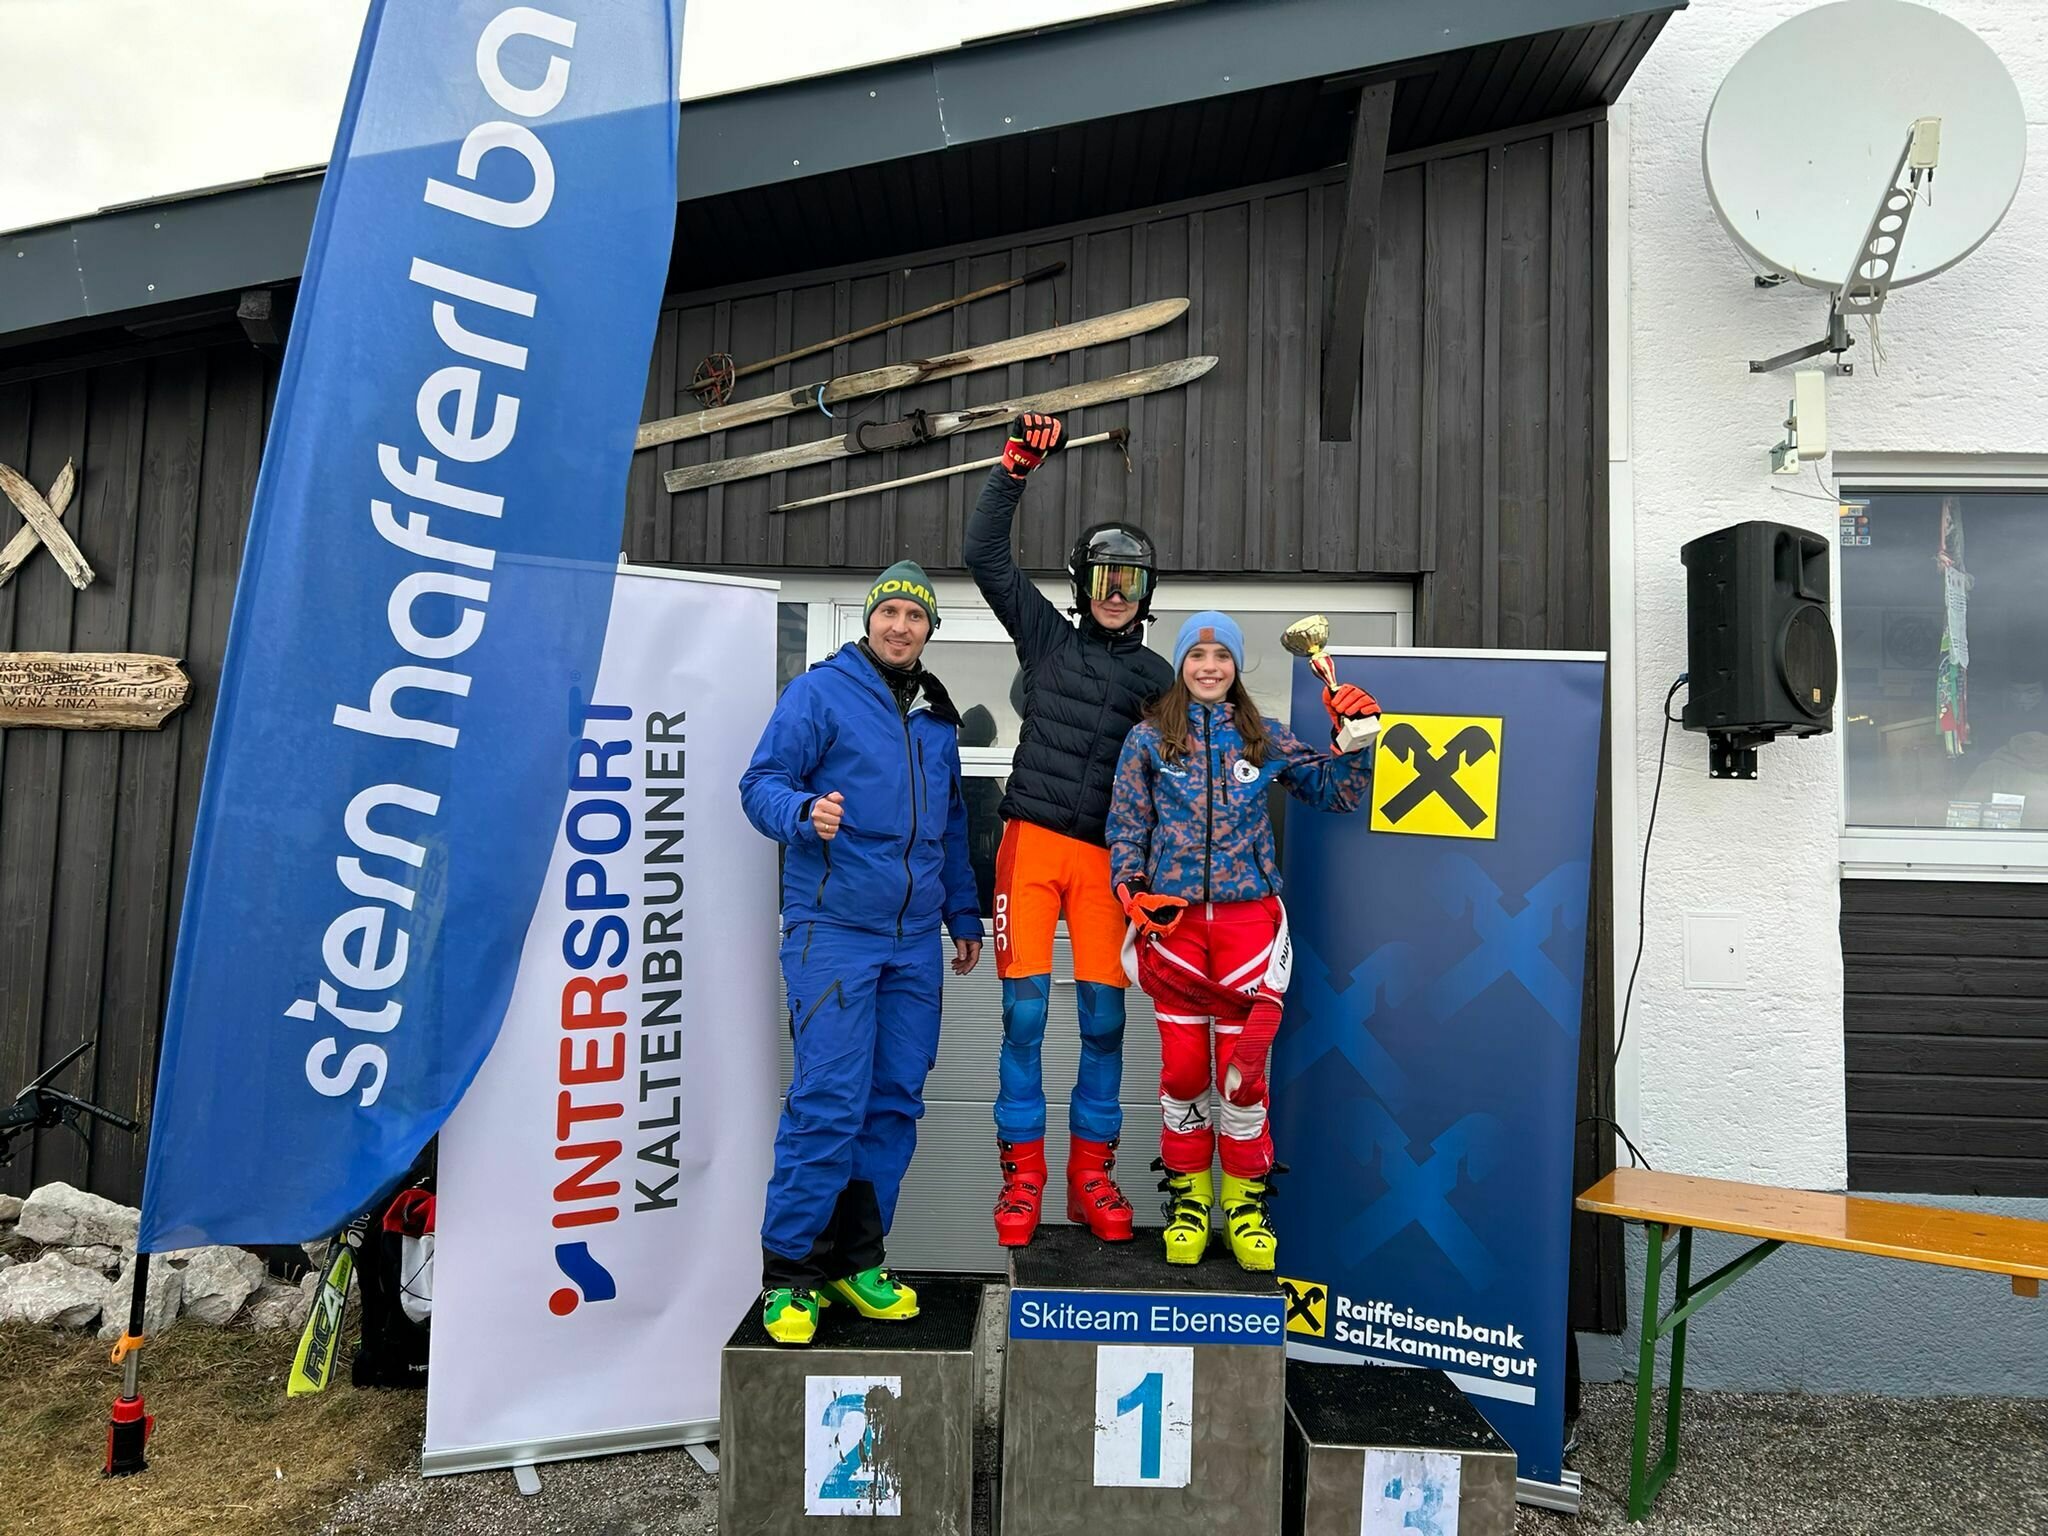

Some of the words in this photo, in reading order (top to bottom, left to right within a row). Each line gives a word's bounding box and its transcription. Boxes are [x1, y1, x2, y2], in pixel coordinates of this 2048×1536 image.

[423, 7, 578, 229] ba
[332, 256, 537, 749] hafferl
[1008, 449, 1031, 466] LEKI
[866, 579, 937, 614] ATOMIC
[283, 783, 441, 1108] stern
[551, 687, 633, 1228] INTERSPORT
[634, 710, 687, 1213] KALTENBRUNNER
[303, 1281, 346, 1387] RC4
[1019, 1301, 1139, 1332] Skiteam
[1150, 1306, 1281, 1335] Ebensee
[1334, 1321, 1538, 1378] Salzkammergut
[1336, 1296, 1525, 1350] Raiffeisenbank
[819, 1394, 891, 1499] 2
[1117, 1372, 1164, 1479] 1
